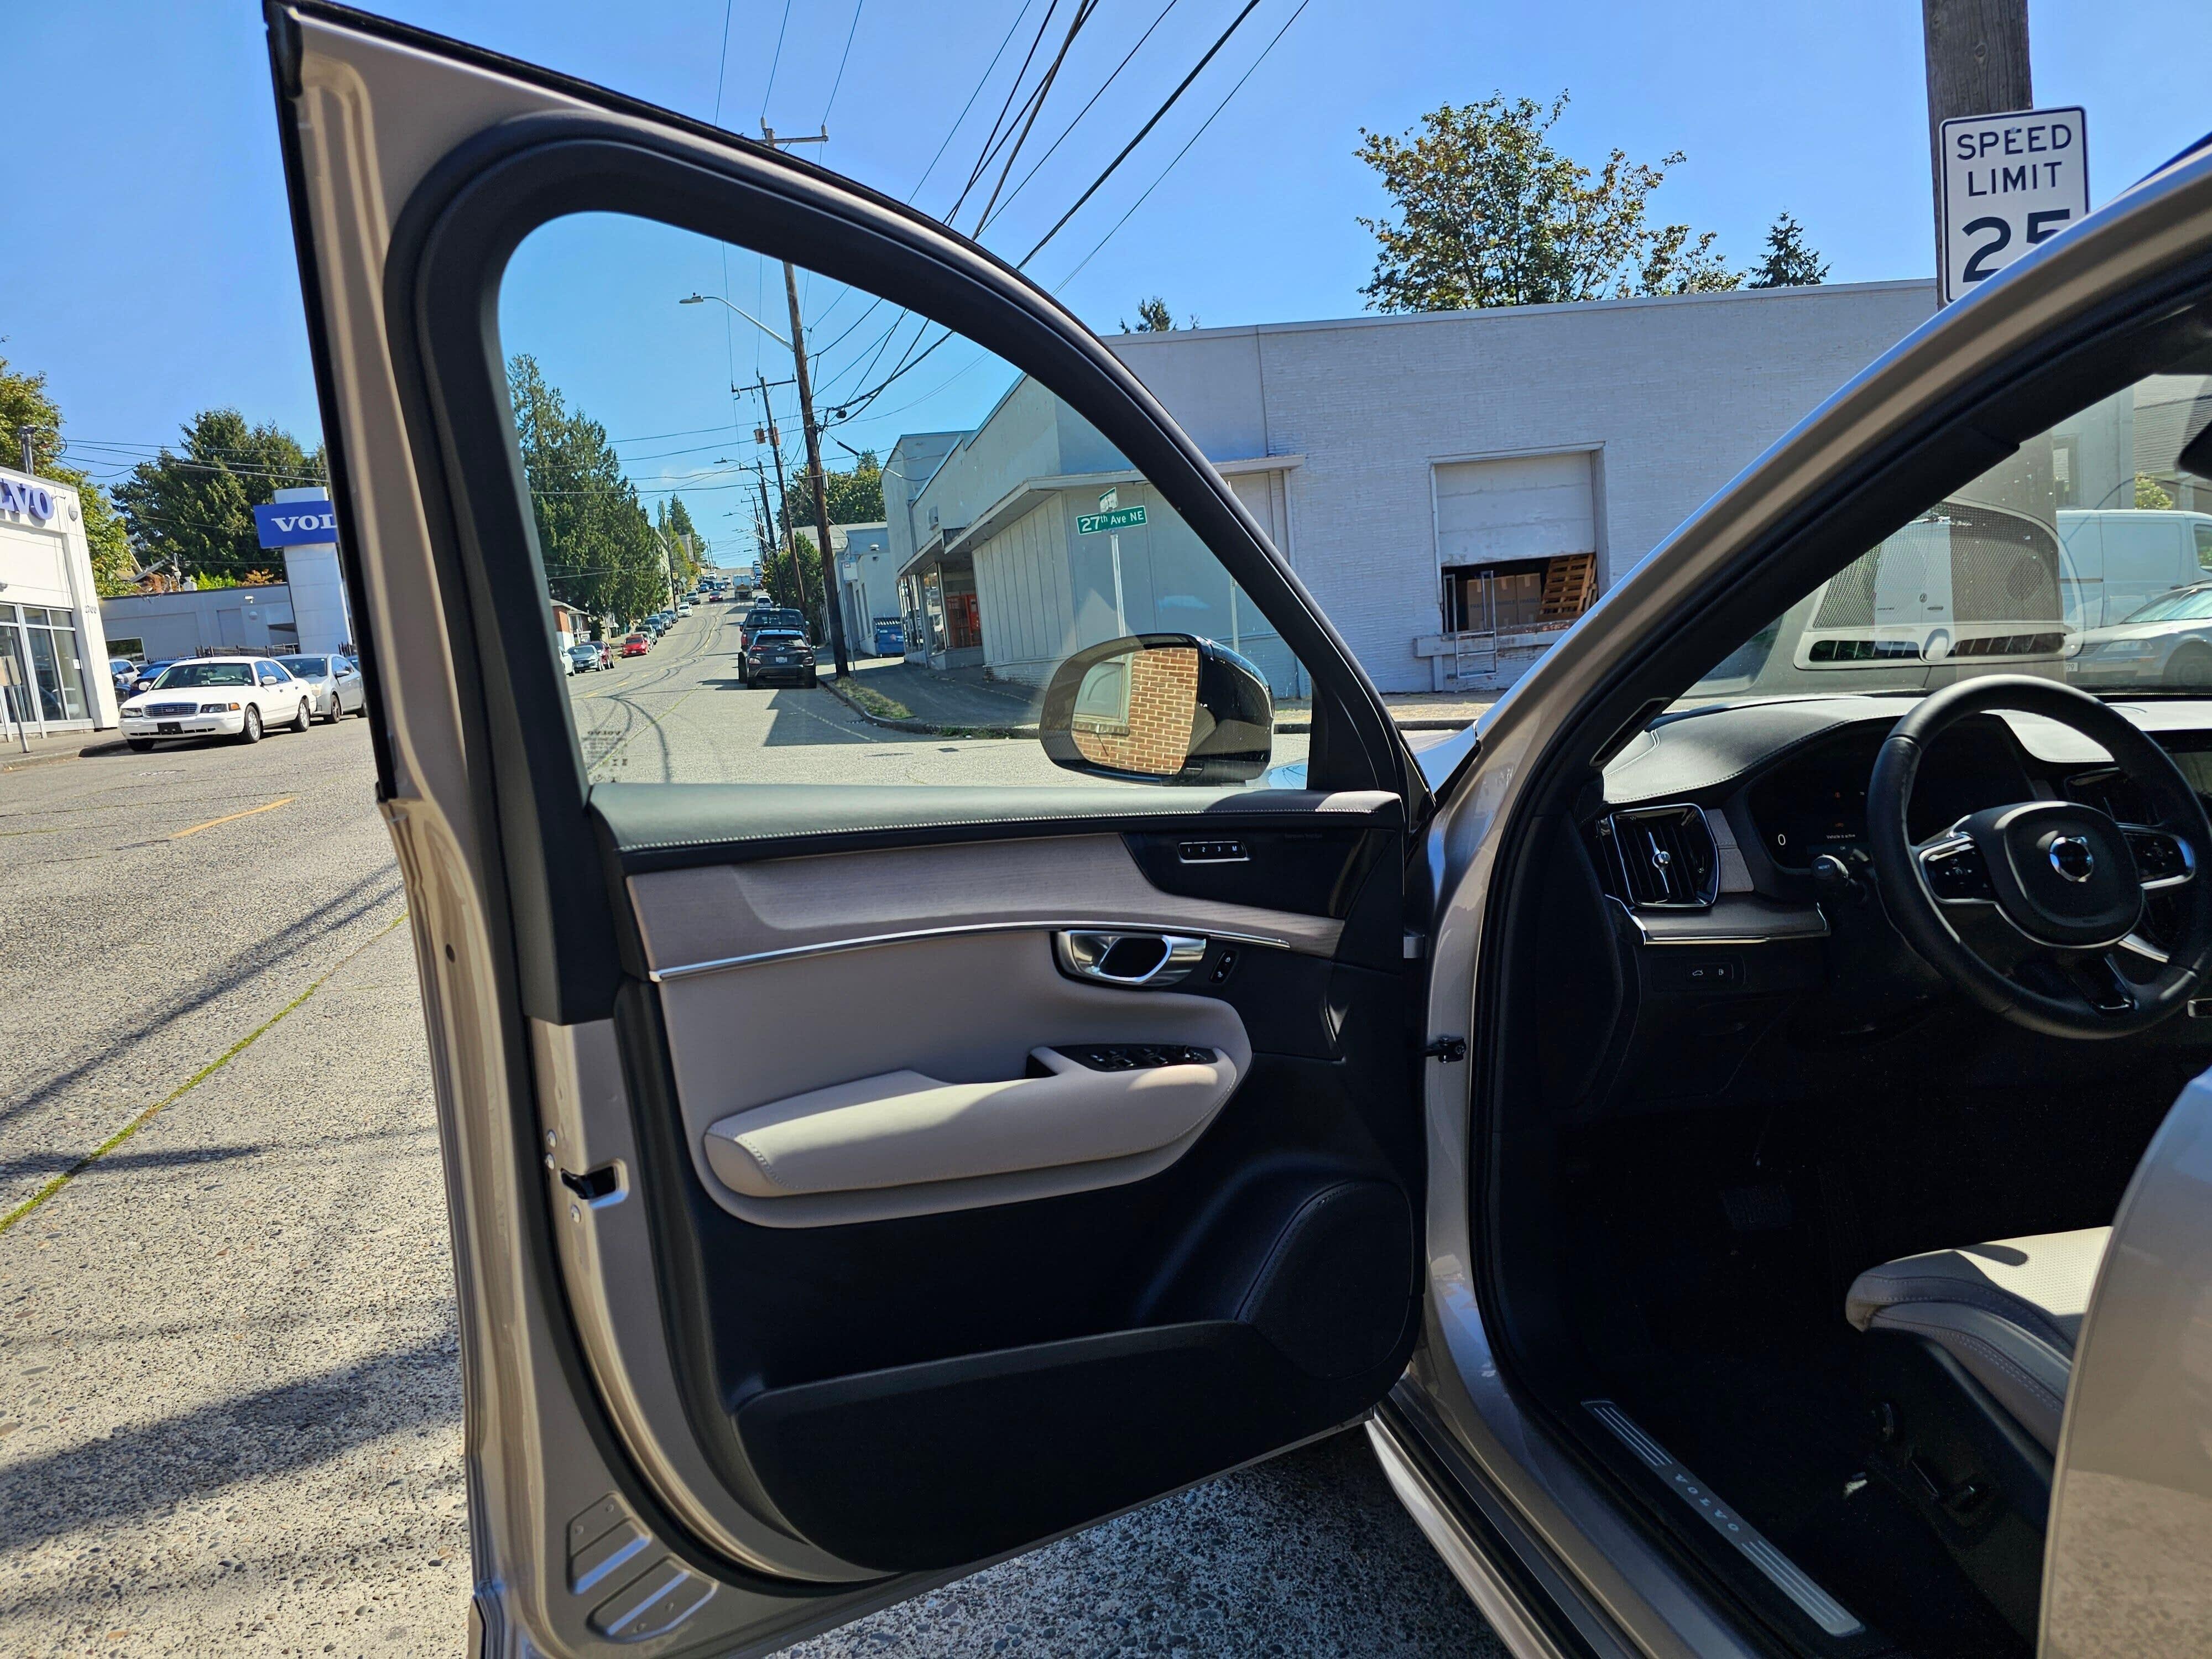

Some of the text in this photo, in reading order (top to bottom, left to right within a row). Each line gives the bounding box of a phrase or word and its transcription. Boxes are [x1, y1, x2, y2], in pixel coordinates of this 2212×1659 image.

[1957, 124, 2072, 160] SPEED
[1968, 161, 2063, 197] LIMIT
[271, 513, 338, 532] VOL
[1081, 511, 1144, 531] 27th Ave NE
[1778, 834, 1786, 845] 0
[1674, 1473, 1740, 1533] VOLVO
